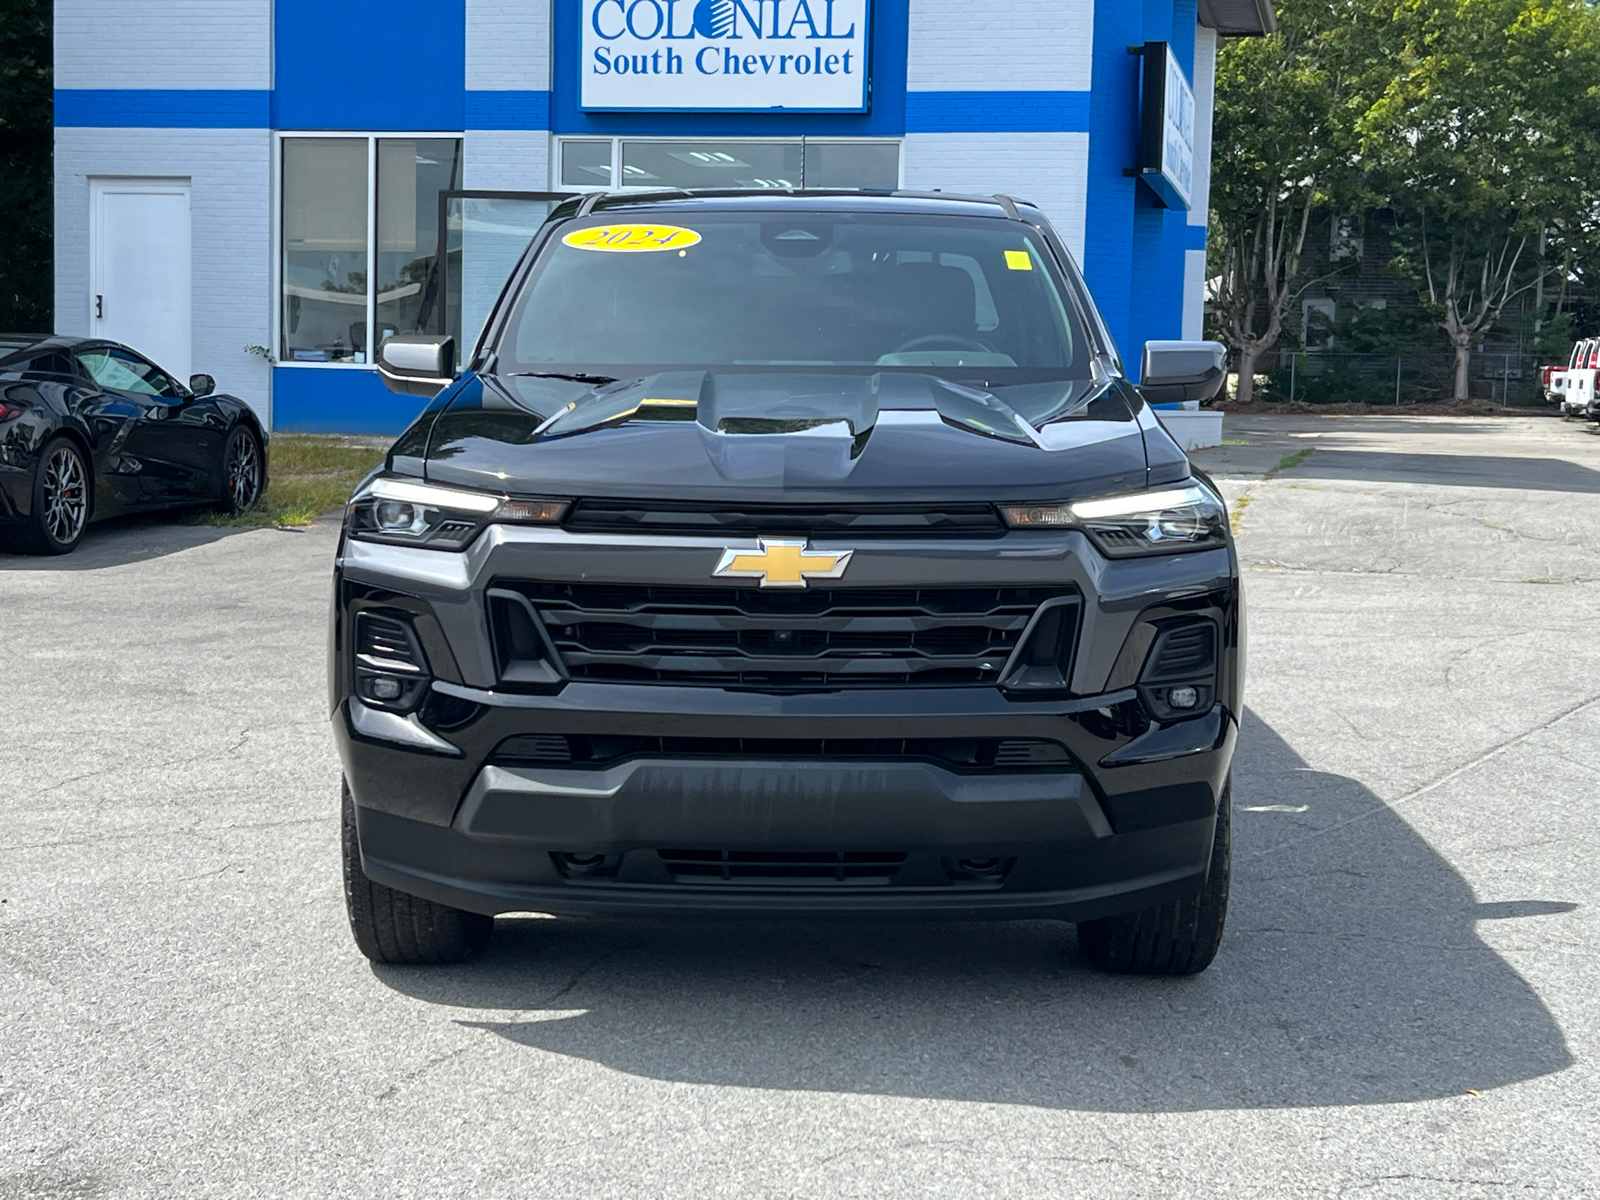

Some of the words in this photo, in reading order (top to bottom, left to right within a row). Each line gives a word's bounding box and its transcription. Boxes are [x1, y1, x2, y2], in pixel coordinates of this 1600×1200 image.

[592, 0, 855, 40] COLONIAL
[593, 46, 683, 75] South
[695, 46, 854, 75] Chevrolet
[582, 230, 681, 245] 2024
